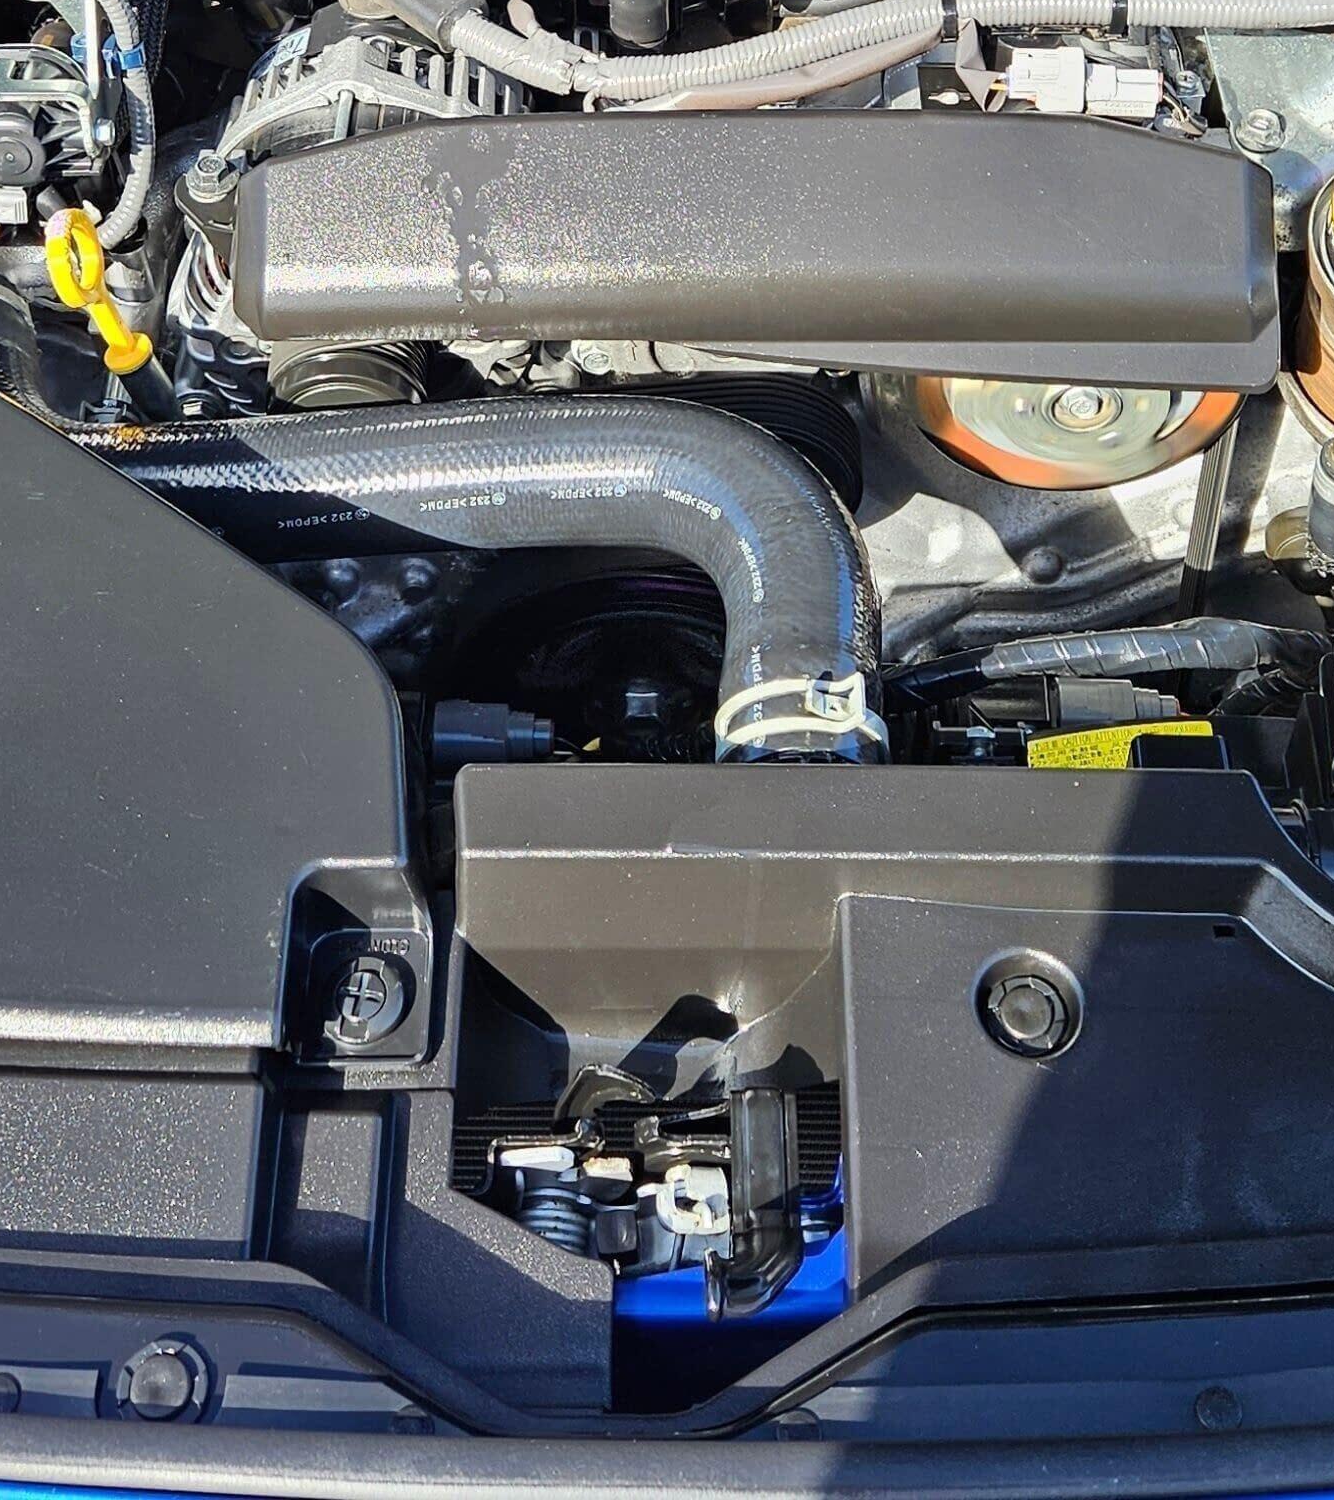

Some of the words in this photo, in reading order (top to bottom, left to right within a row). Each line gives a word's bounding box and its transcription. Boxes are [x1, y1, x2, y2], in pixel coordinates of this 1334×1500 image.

[595, 487, 613, 498] 232
[469, 494, 492, 506] 232
[331, 511, 353, 523] 232
[1062, 733, 1091, 747] CAUTION
